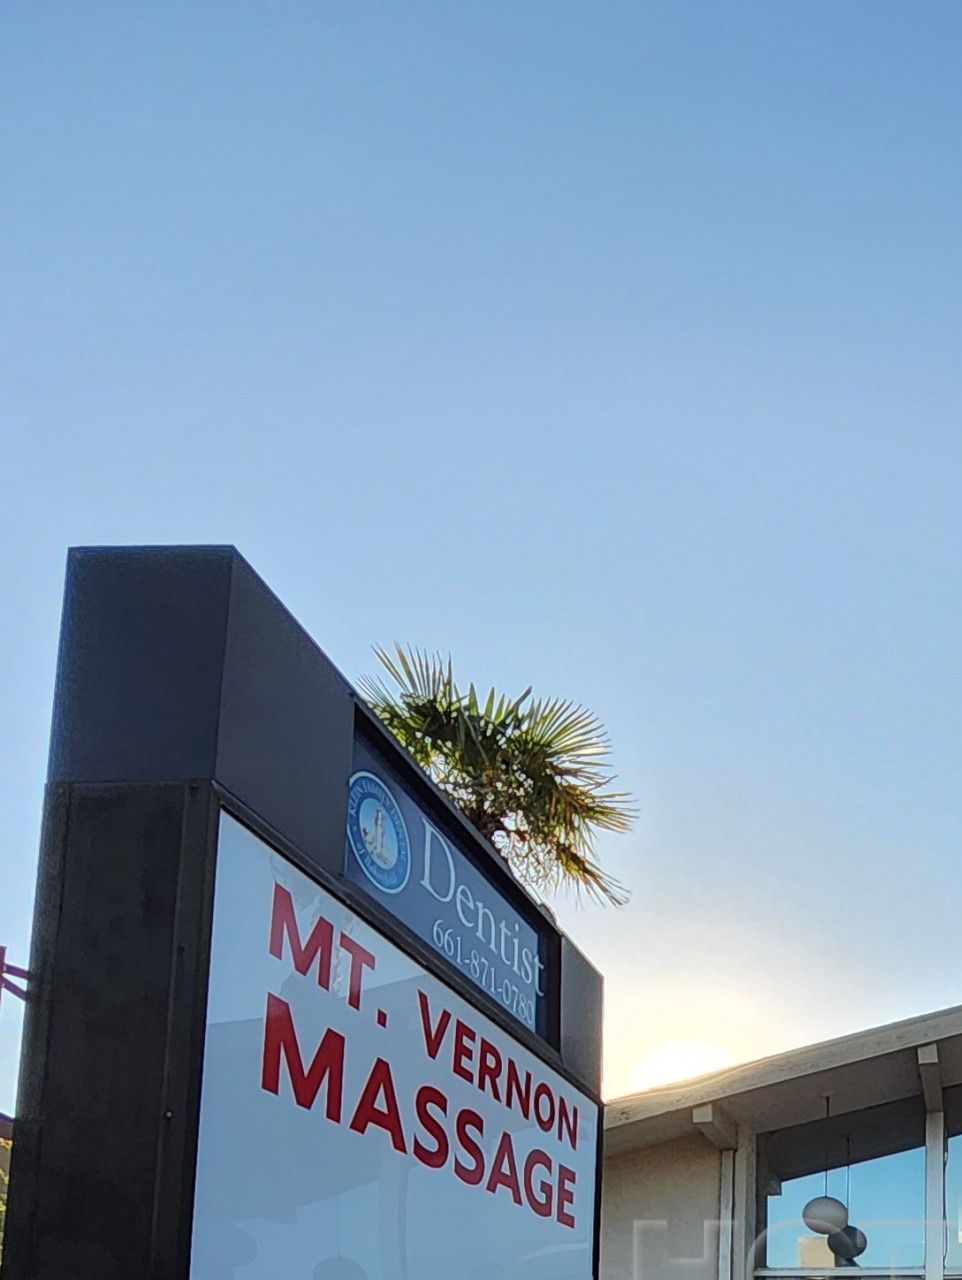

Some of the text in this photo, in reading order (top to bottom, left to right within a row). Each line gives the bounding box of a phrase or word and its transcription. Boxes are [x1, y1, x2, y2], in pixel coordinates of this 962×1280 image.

[419, 816, 545, 997] Dentist
[432, 918, 536, 1026] 661-871-0780
[261, 993, 577, 1230] MASSAGE
[268, 882, 579, 1151] MT. VERNON
